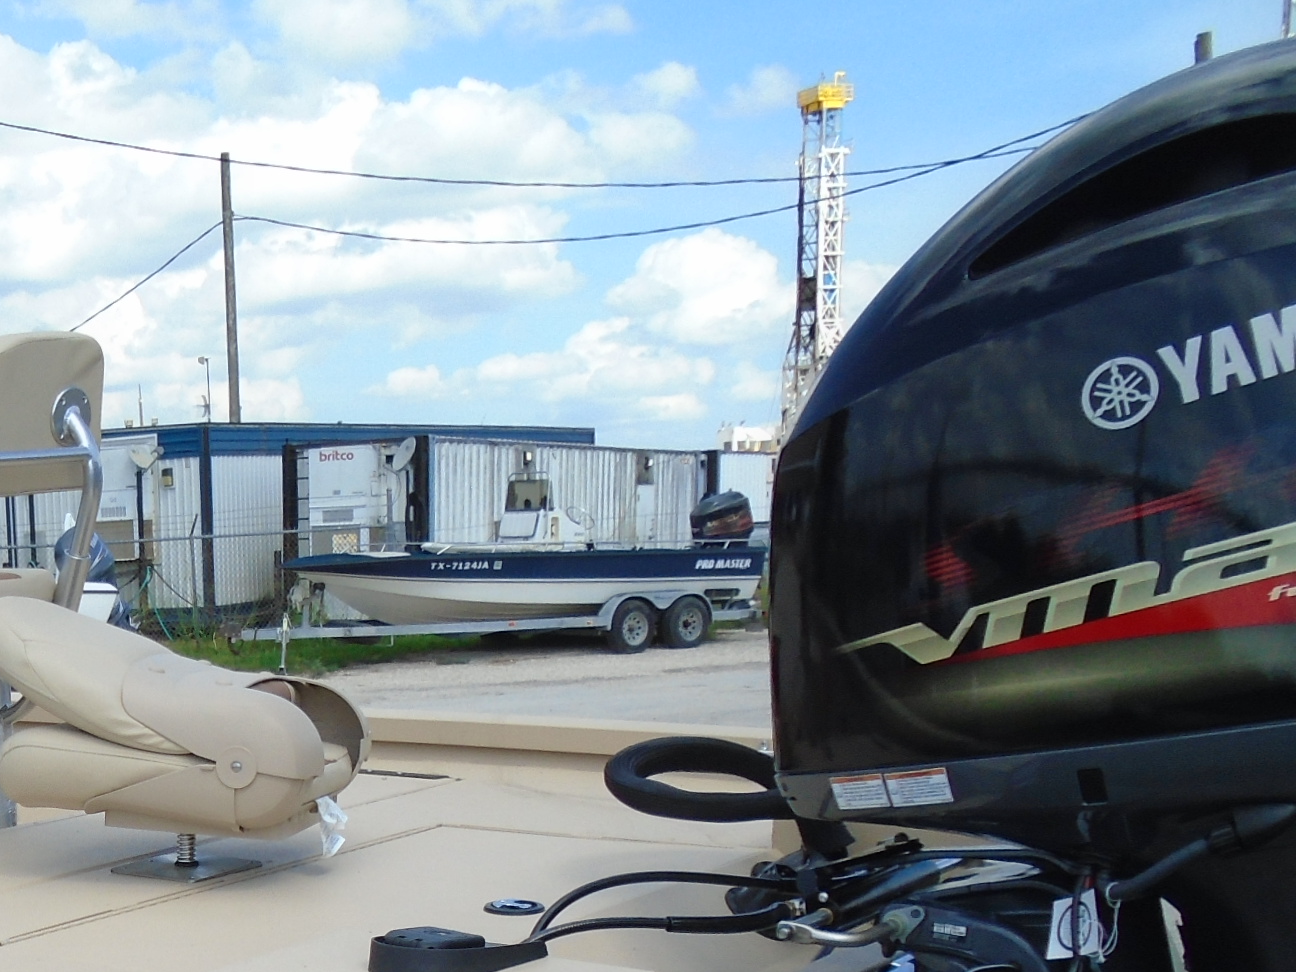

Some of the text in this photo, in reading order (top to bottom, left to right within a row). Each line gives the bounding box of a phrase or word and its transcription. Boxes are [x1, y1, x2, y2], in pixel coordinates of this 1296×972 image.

[319, 450, 354, 462] britco
[695, 558, 752, 570] PRO MASTER
